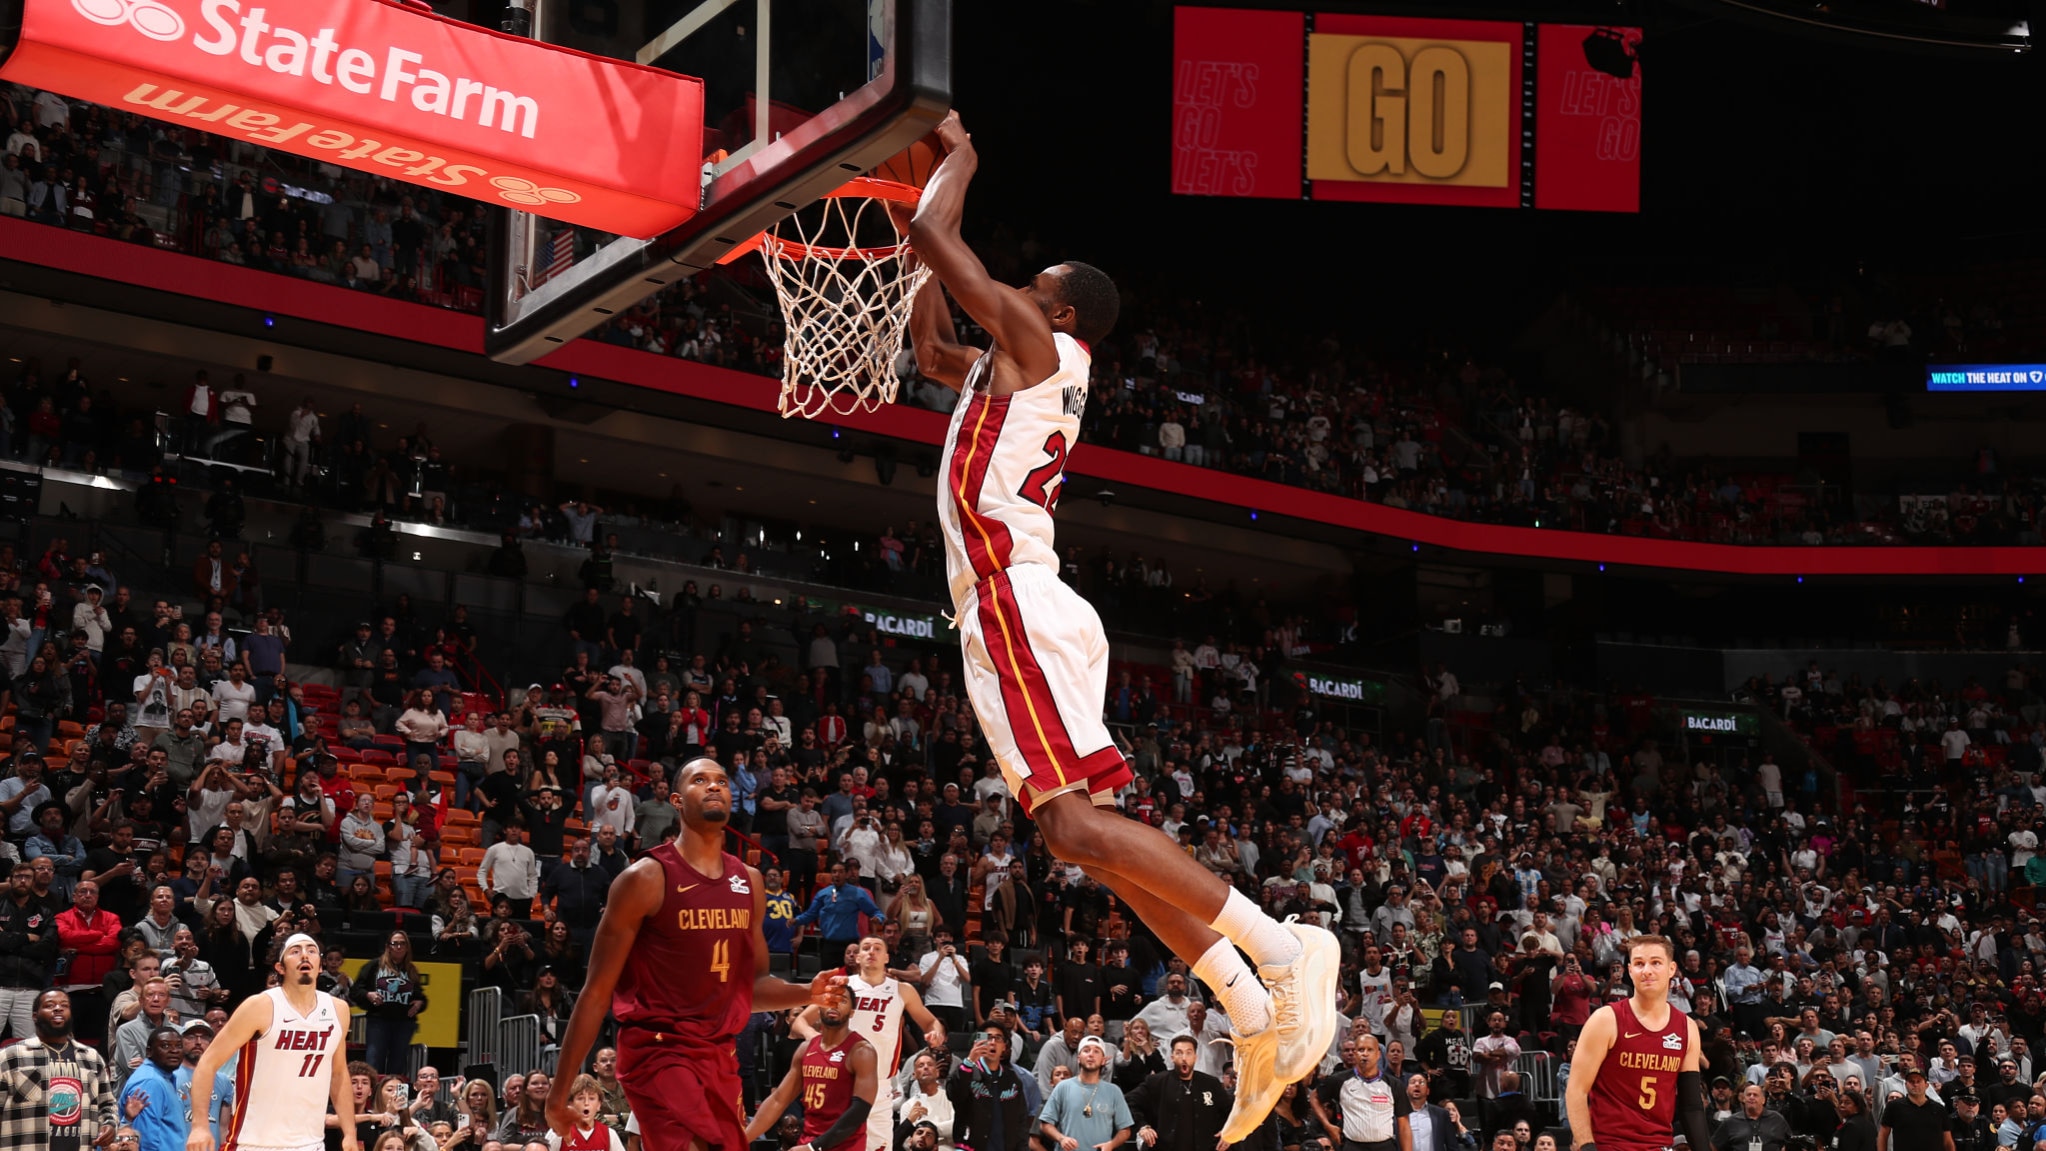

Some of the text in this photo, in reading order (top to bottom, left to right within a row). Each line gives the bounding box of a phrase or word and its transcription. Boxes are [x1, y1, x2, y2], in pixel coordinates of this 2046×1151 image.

[1174, 59, 1260, 109] LET'S
[1347, 43, 1469, 180] GO
[1175, 104, 1222, 151] GO
[1596, 116, 1642, 162] GO
[1172, 149, 1259, 196] LET'S
[1931, 372, 2028, 385] WATCH THE HEAT ON
[678, 908, 750, 931] CLEVELAND
[767, 899, 793, 920] 30
[710, 938, 730, 983] 4
[872, 1014, 886, 1032] 5
[274, 1024, 334, 1051] HEAT
[298, 1053, 325, 1077] 11
[1619, 1051, 1681, 1073] CLEVELAND
[804, 1083, 827, 1110] 45
[1638, 1076, 1657, 1110] 5
